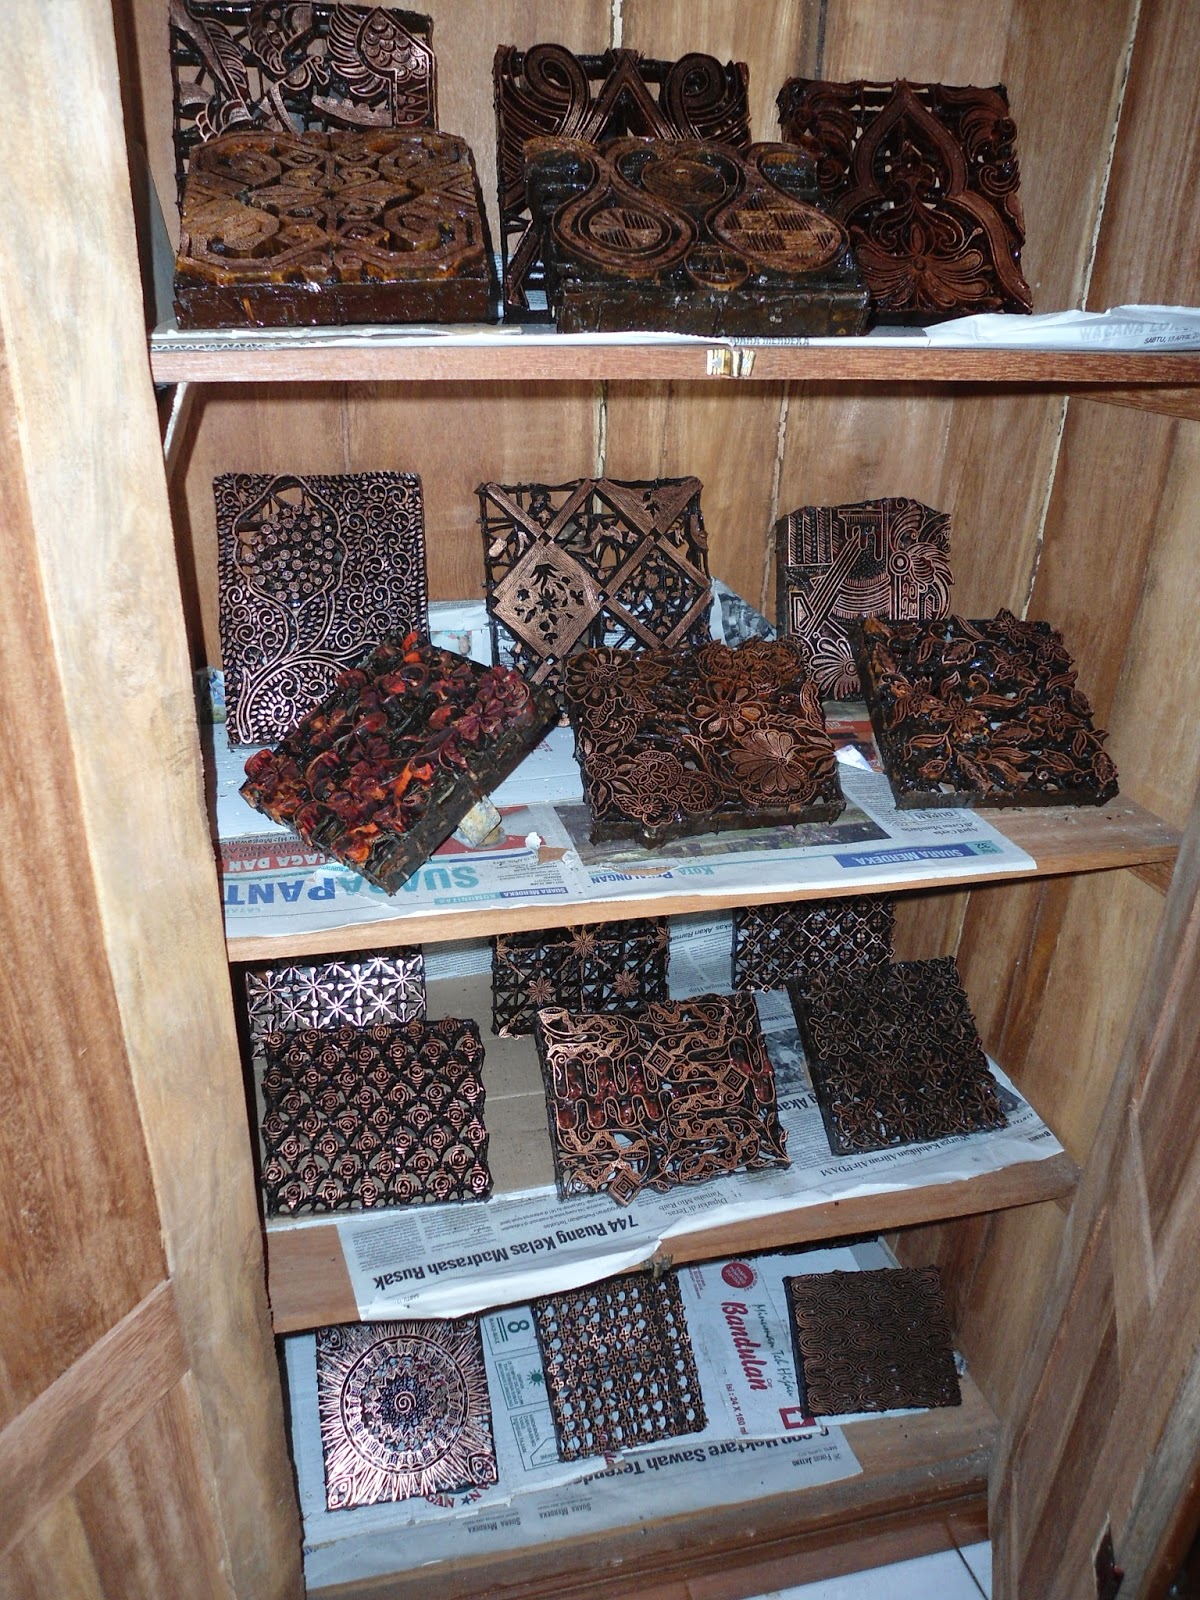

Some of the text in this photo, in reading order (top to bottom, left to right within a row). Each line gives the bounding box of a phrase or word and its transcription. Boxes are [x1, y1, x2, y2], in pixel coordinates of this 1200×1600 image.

[974, 842, 989, 850] 32
[853, 851, 919, 866] MERDEKA
[921, 848, 964, 858] SUARA
[228, 857, 269, 872] DAN
[337, 865, 479, 896] SUAA
[590, 871, 673, 885] PONGAN
[503, 887, 565, 898] SUARA MERDEKA
[694, 927, 713, 936] Akan
[868, 1153, 896, 1165] Aliran
[819, 1163, 853, 1177] PDAM
[677, 1197, 692, 1206] Mio
[693, 1190, 722, 1202] Yamaha
[658, 1202, 676, 1211] Raib
[696, 1196, 727, 1209] Diparkir
[665, 1206, 687, 1217] Teras,
[372, 1214, 638, 1291] 744 Ruang Kelas Madrasah Rusak
[507, 1319, 530, 1334] 8
[720, 1301, 769, 1391] Bandulan
[646, 1448, 705, 1470] Sawah
[566, 1461, 644, 1486] Terend
[538, 1507, 568, 1519] MERDEKA
[571, 1502, 591, 1512] SUARA
[467, 1522, 497, 1534] MERDEKA
[500, 1517, 521, 1527] SUARA
